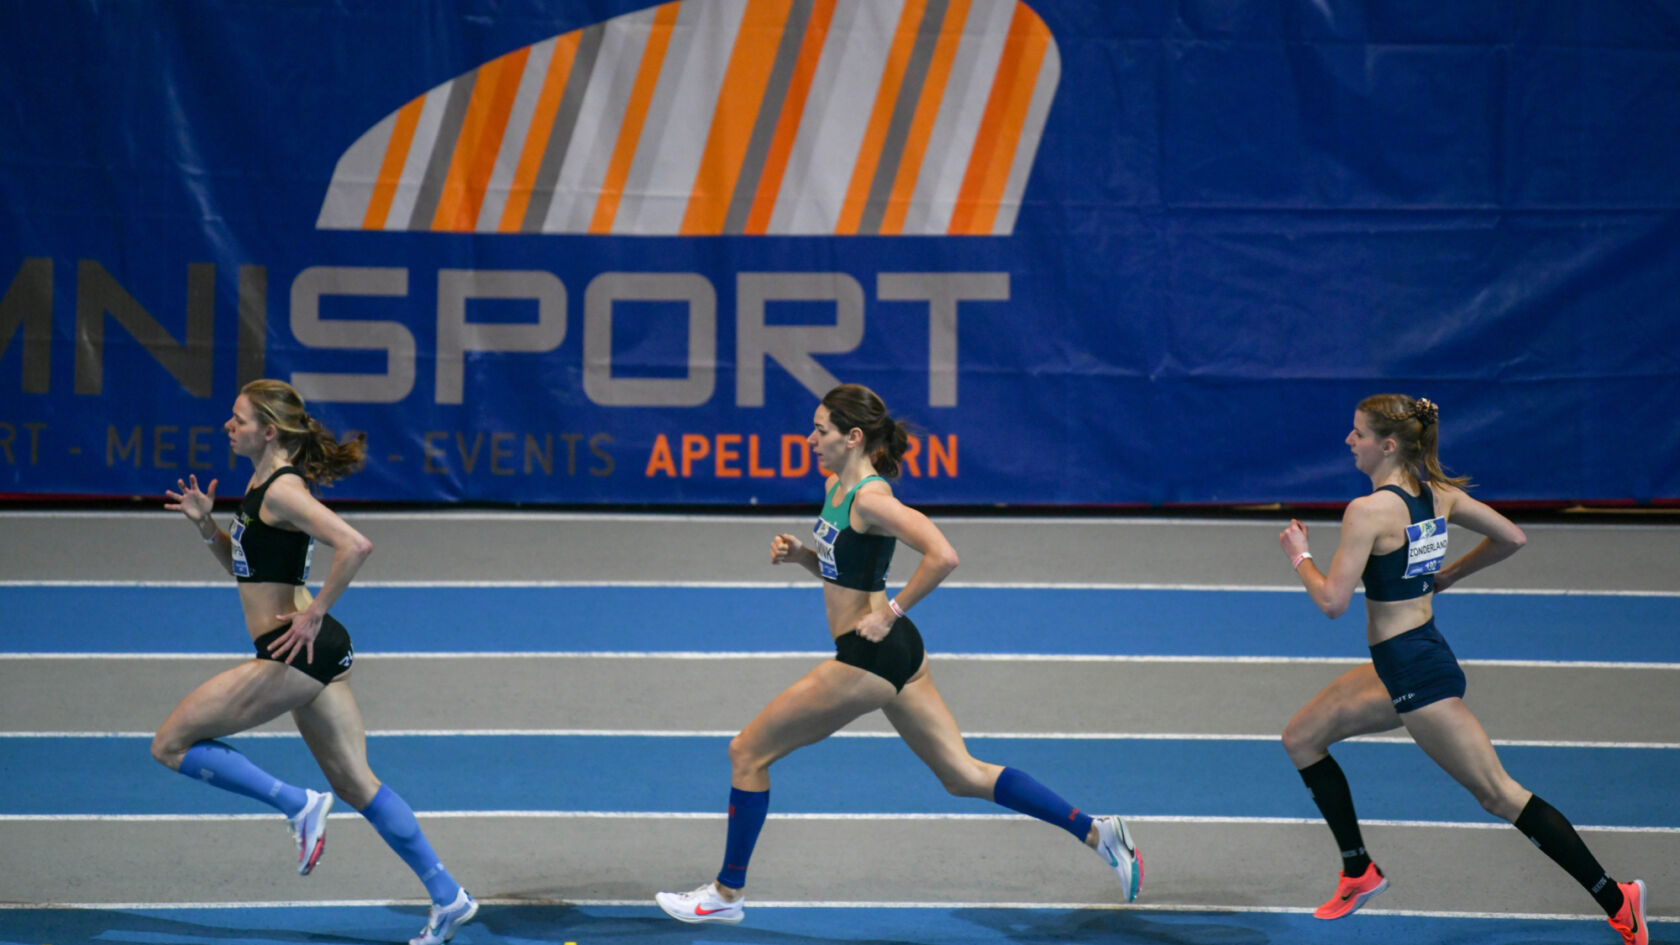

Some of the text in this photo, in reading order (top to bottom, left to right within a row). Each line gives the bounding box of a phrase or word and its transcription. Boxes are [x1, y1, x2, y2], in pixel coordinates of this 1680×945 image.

[424, 432, 615, 477] EVENTS
[645, 433, 958, 479] APELDRN
[1410, 540, 1447, 557] ZONDERLAND
